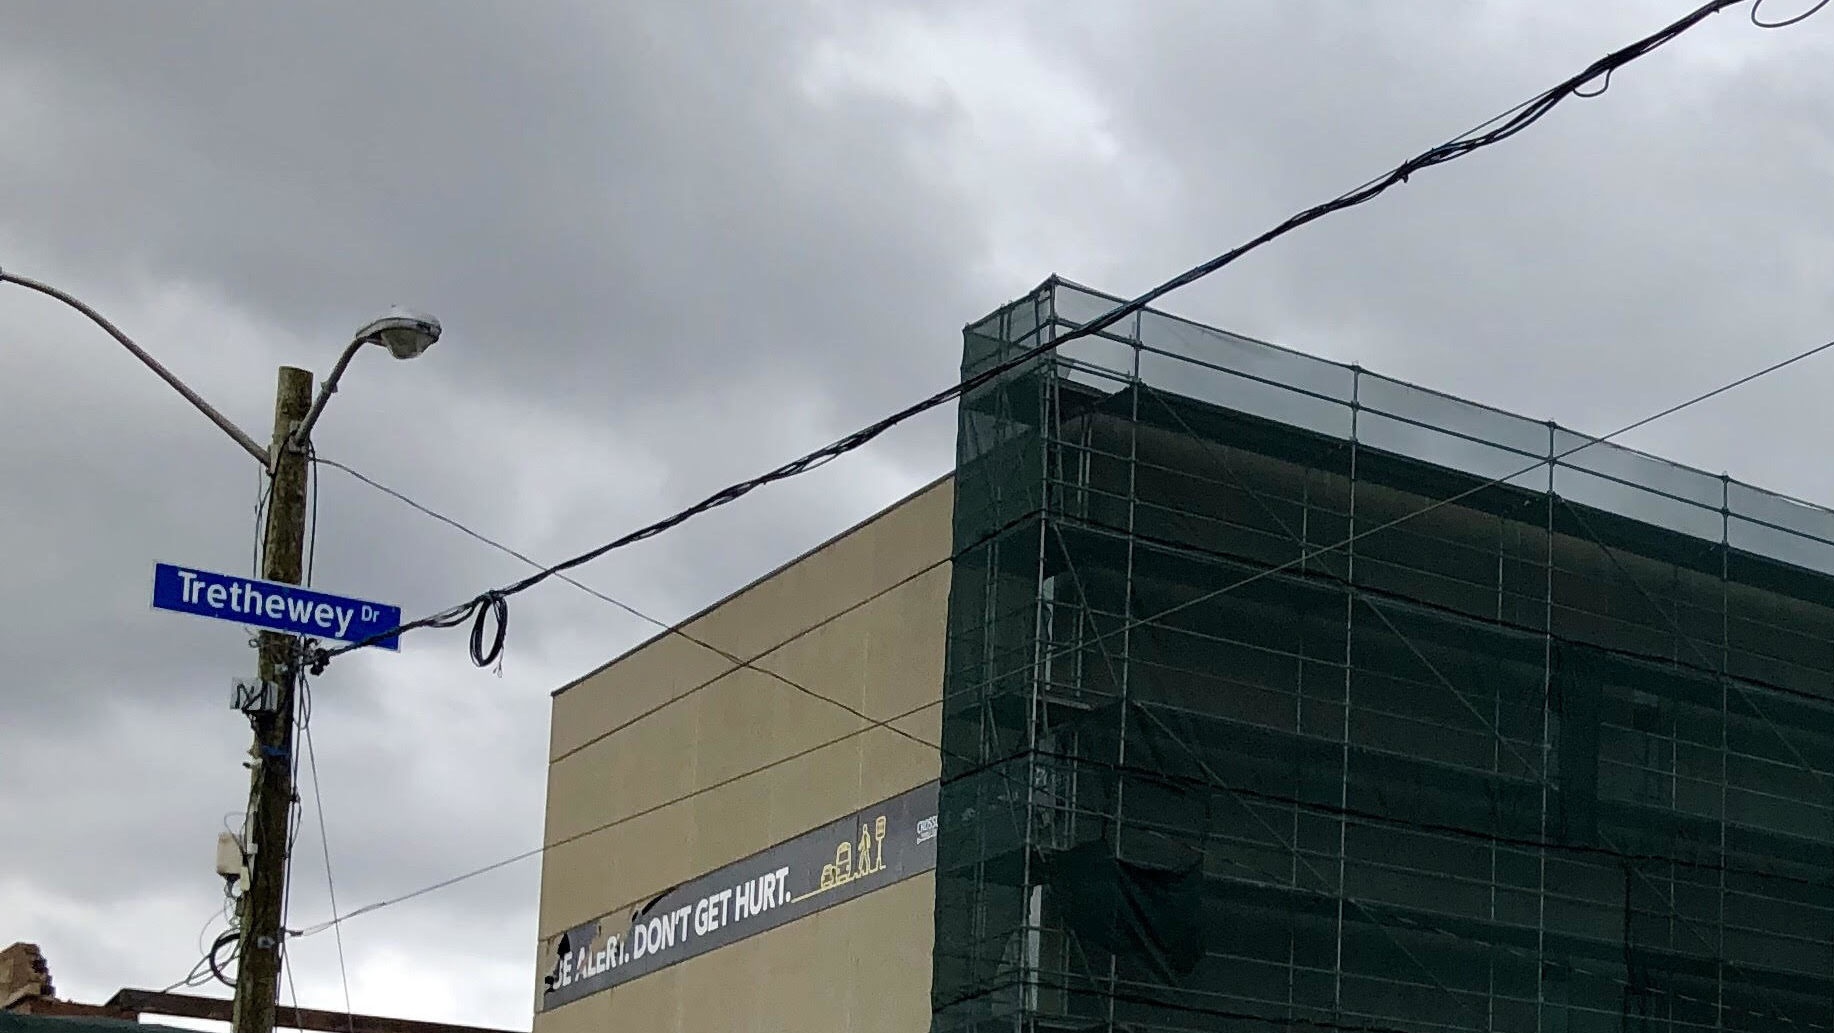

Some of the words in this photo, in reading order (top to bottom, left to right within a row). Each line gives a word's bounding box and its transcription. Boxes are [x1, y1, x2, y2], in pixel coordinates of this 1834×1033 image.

[177, 570, 354, 638] Trethewey
[360, 604, 380, 623] Dr
[633, 905, 692, 960] DON'T
[694, 889, 732, 936] GET
[735, 866, 791, 922] HURT.
